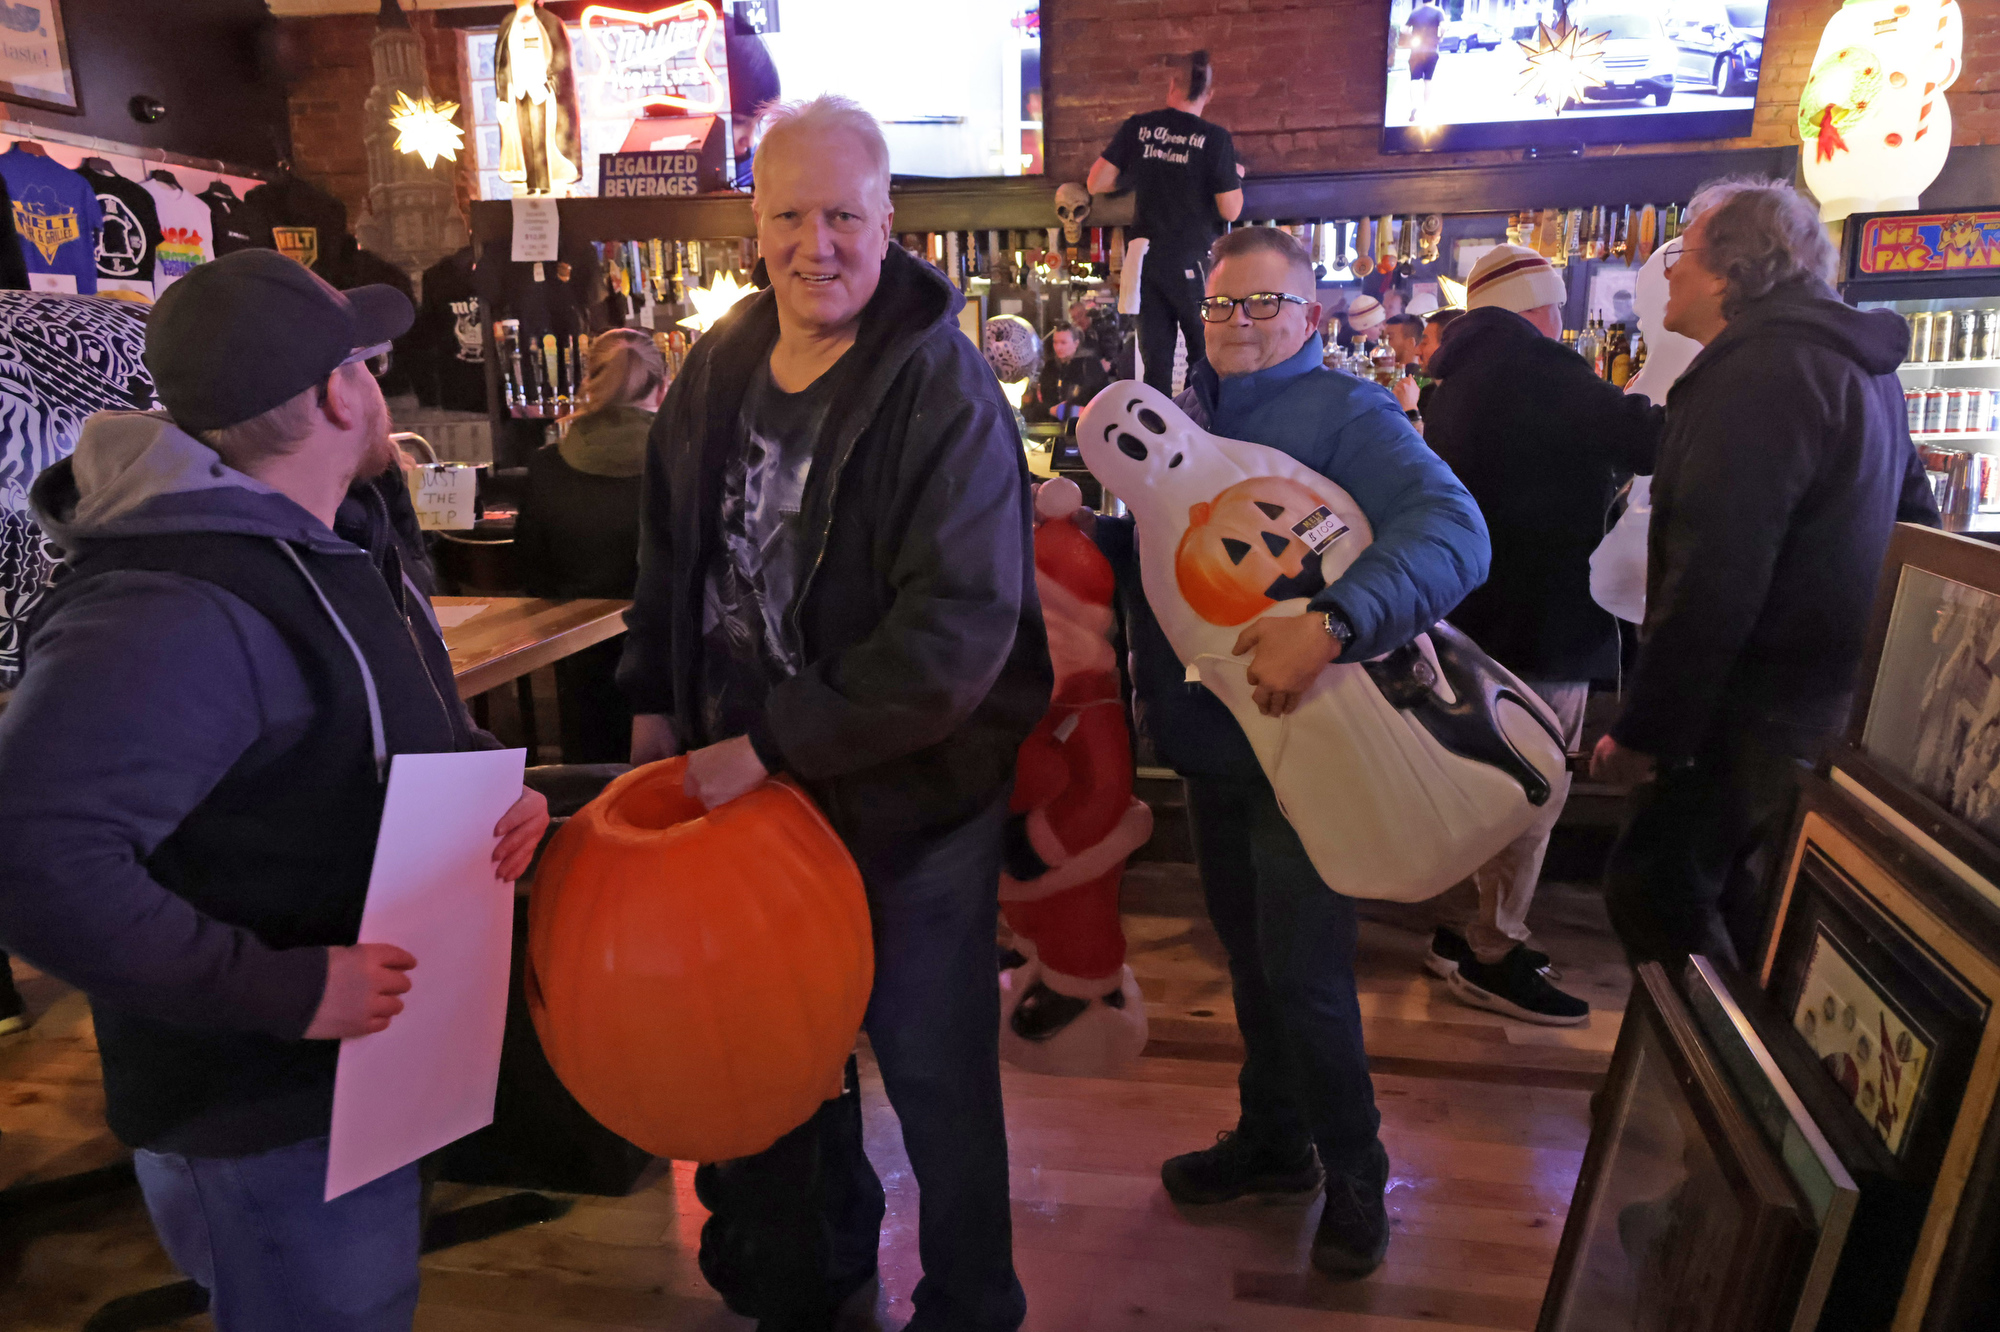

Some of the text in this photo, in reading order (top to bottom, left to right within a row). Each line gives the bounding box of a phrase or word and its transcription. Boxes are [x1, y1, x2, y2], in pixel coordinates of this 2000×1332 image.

[746, 8, 767, 26] 14
[602, 18, 706, 66] Miller
[606, 155, 698, 176] LEGALIZED
[605, 176, 698, 198] BEVERAGES
[45, 229, 74, 244] GRILLED
[1880, 226, 1921, 245] MS.
[415, 469, 458, 490] JUST
[423, 492, 457, 504] THE
[415, 510, 457, 526] TIP
[1302, 511, 1325, 530] MELT
[1307, 520, 1334, 542] $100
